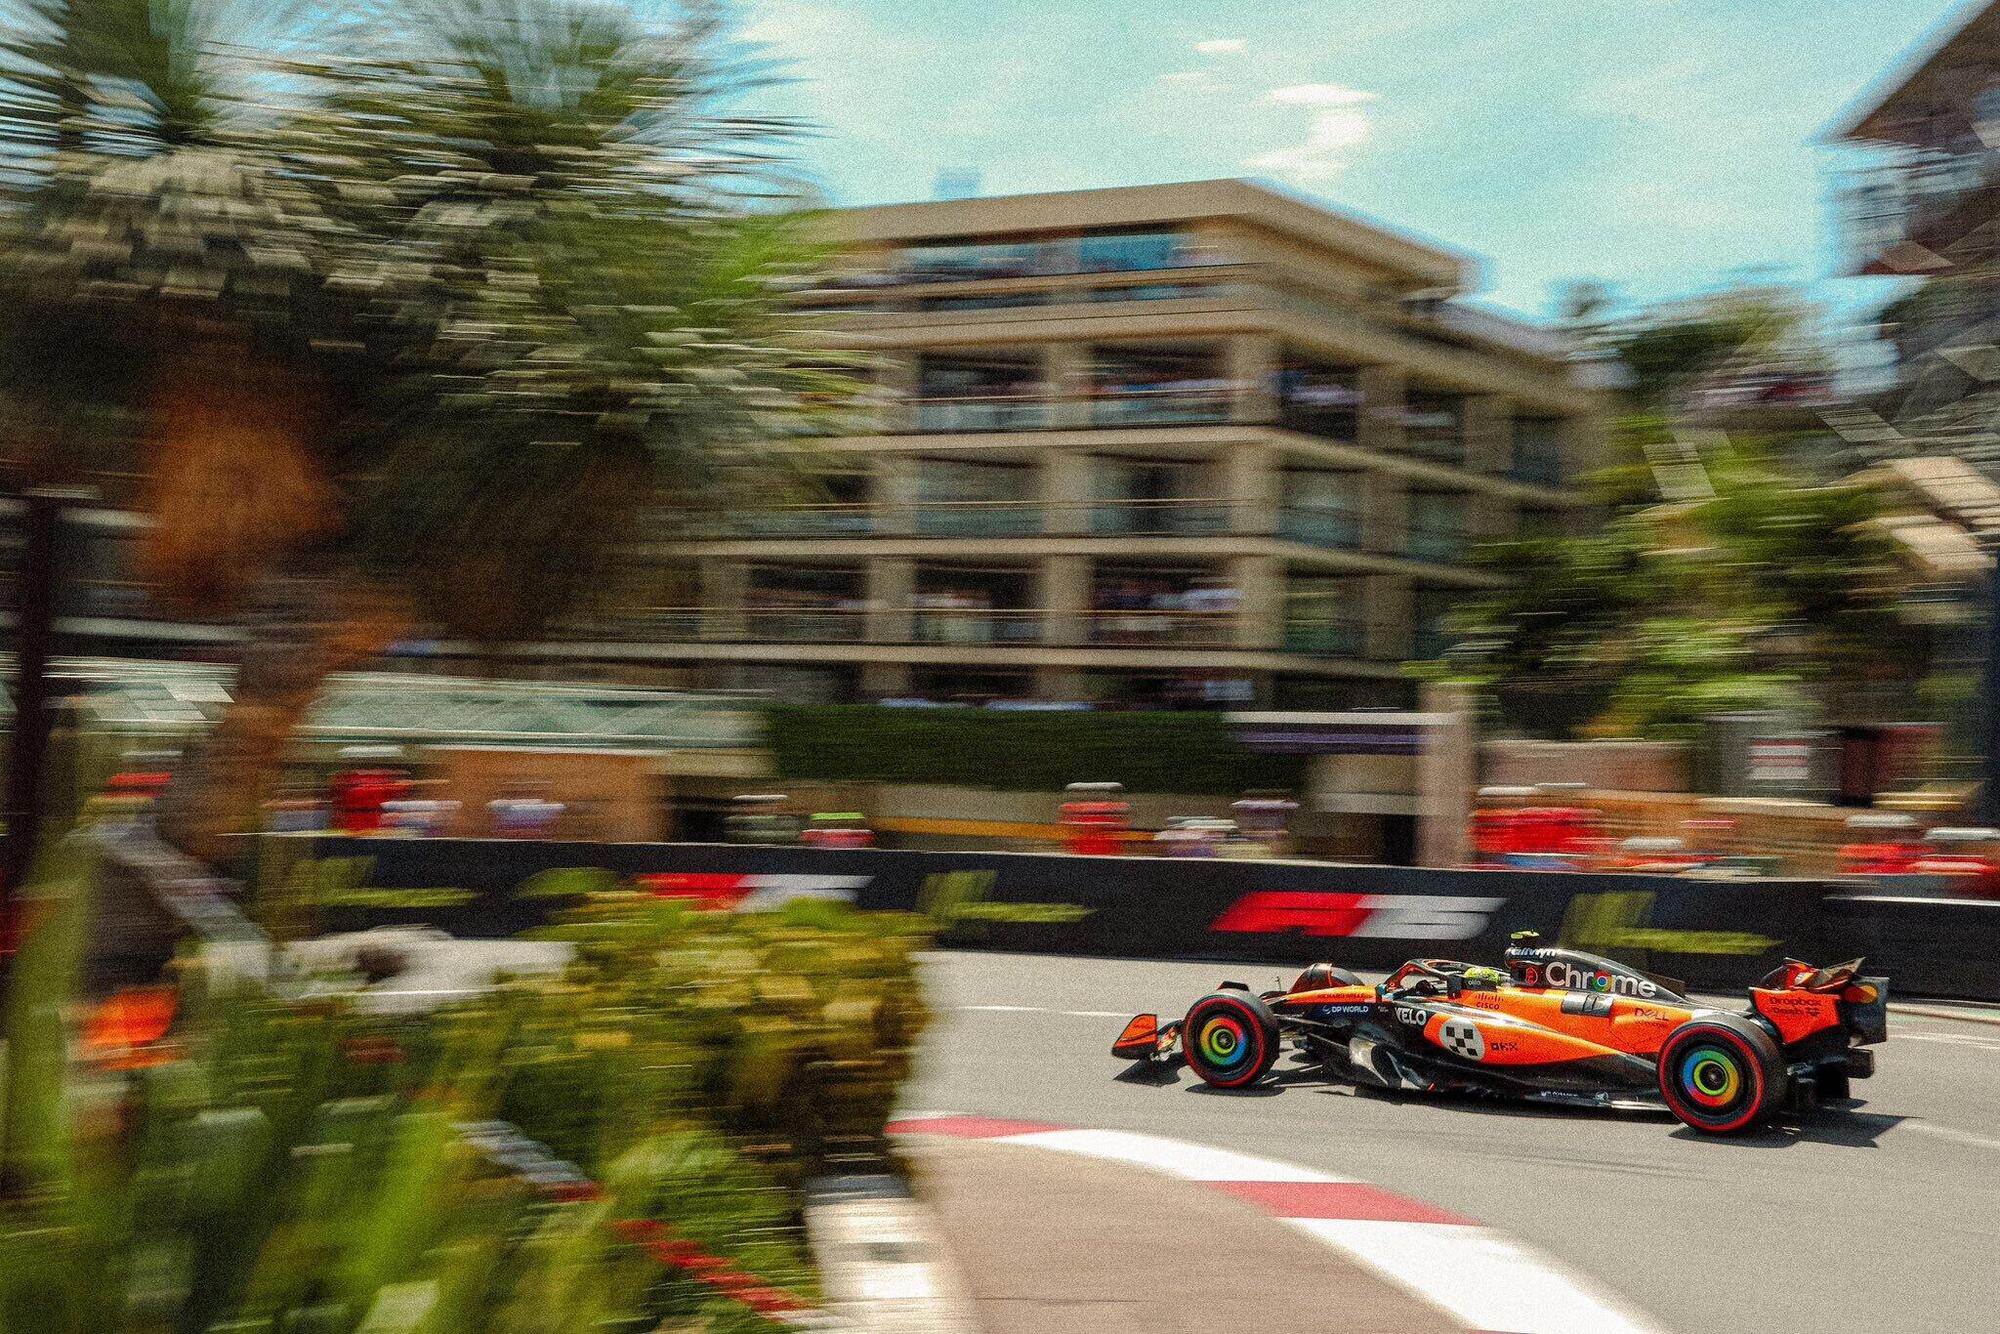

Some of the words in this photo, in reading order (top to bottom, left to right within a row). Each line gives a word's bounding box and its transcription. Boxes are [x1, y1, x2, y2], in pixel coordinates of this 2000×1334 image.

[1545, 961, 1657, 998] Chrome
[1331, 1005, 1342, 1013] DP
[1343, 1005, 1369, 1013] WORLD
[1394, 1007, 1427, 1026] VELO
